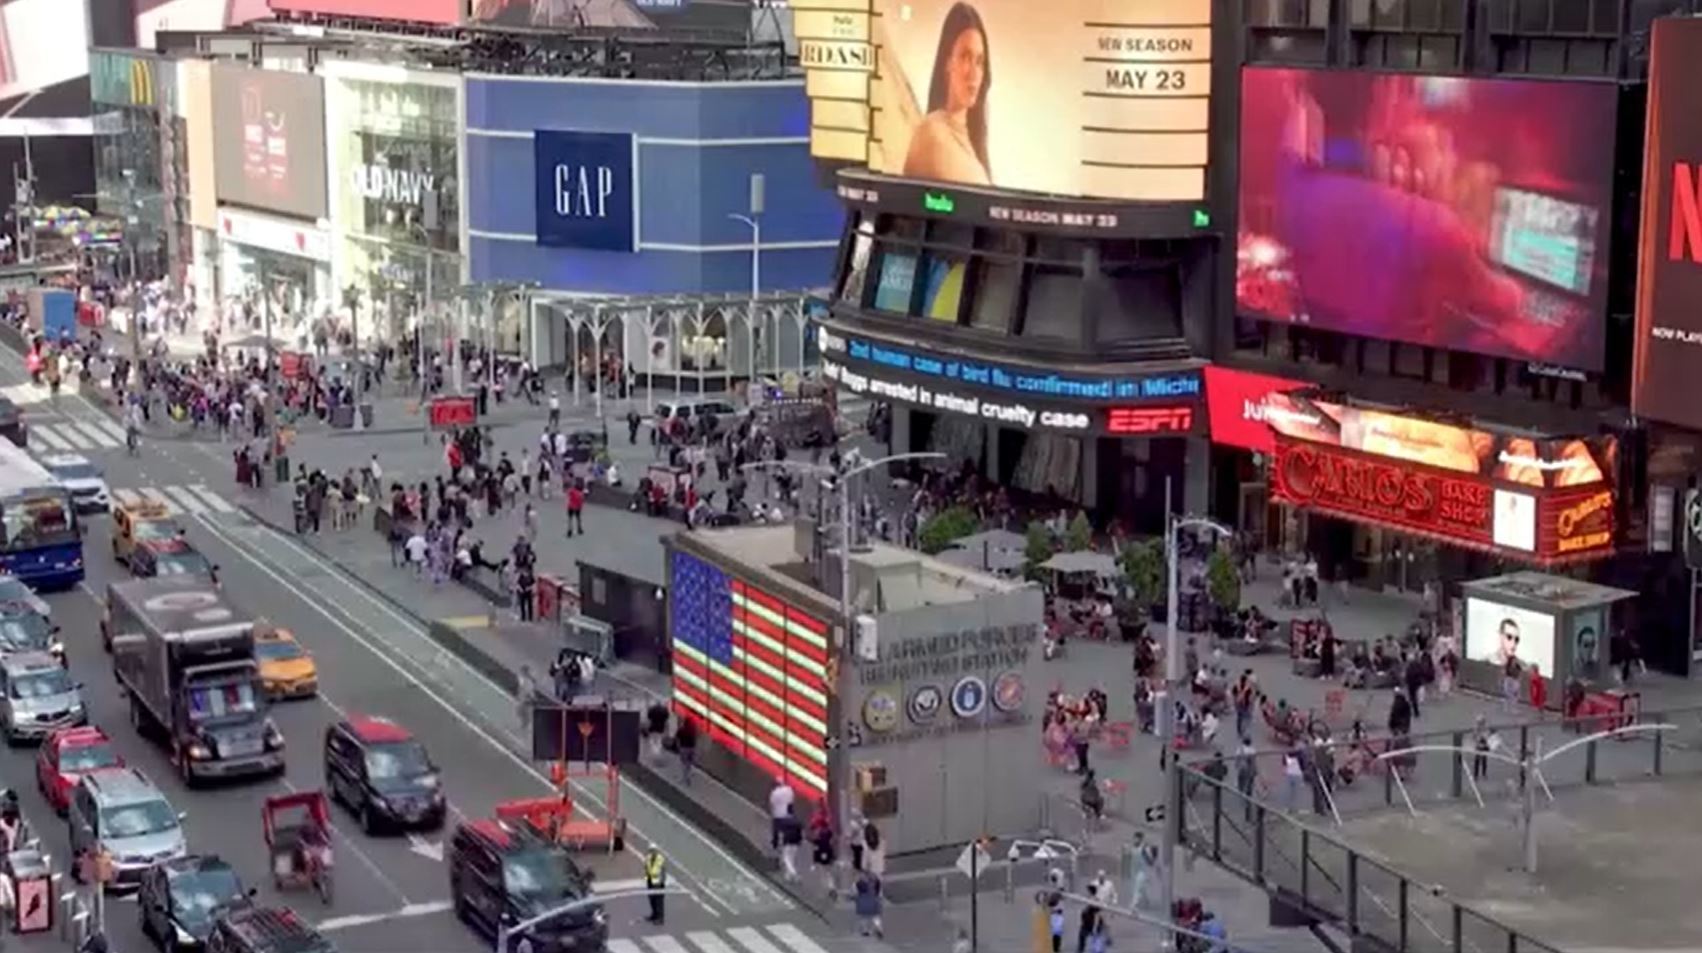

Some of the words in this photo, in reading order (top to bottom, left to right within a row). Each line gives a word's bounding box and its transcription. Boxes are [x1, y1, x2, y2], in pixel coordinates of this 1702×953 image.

[1125, 38, 1192, 52] SEASON
[1106, 69, 1147, 89] MAY
[1156, 69, 1185, 90] 23
[351, 163, 383, 198] OLD
[555, 163, 612, 217] GAP
[1012, 209, 1059, 225] SEASON
[1062, 212, 1095, 226] MAY
[872, 347, 911, 369] human
[914, 356, 942, 375] case
[946, 361, 960, 377] of
[962, 362, 989, 384] bird
[1016, 374, 1111, 397] confirmed
[1115, 380, 1138, 397] in
[870, 379, 917, 402] arrested
[920, 386, 932, 404] in
[934, 392, 979, 415] animal
[981, 401, 1036, 427] cruelty
[1040, 410, 1090, 428] case
[1108, 407, 1192, 432] ESPN
